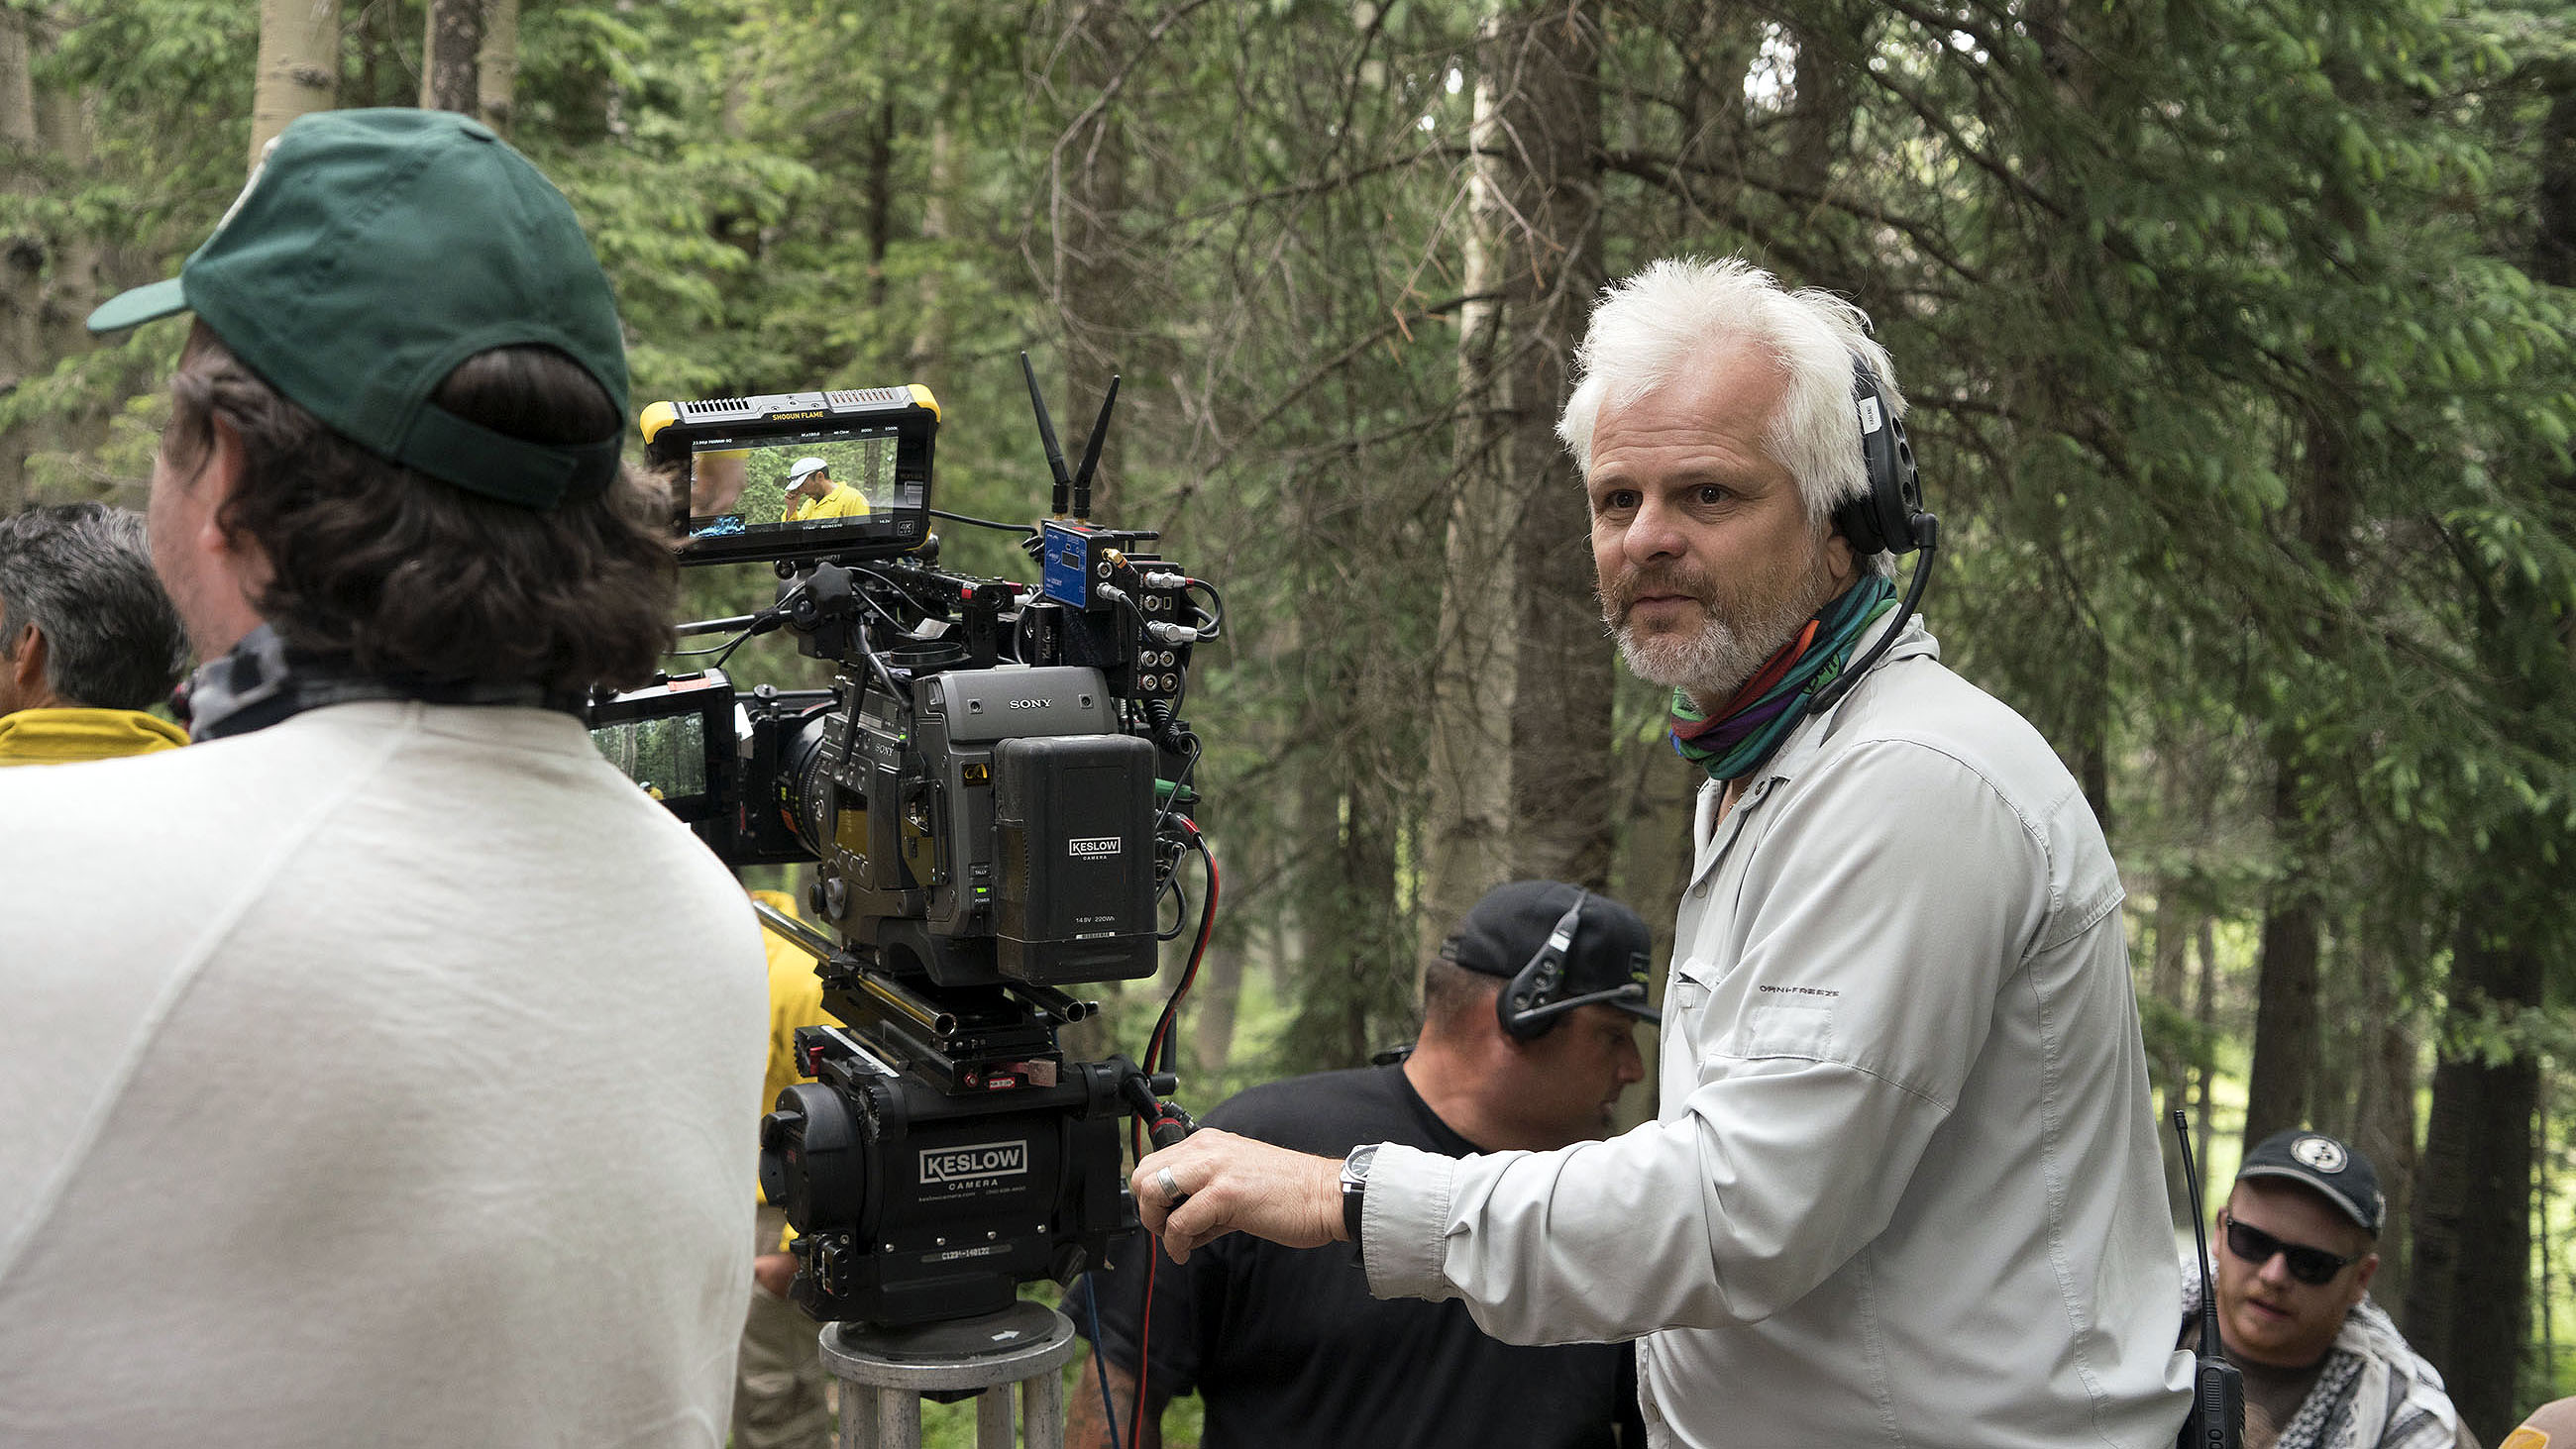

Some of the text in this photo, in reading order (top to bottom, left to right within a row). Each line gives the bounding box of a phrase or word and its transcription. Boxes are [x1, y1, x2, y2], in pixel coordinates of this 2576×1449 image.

[1009, 698, 1052, 709] SONY
[875, 742, 895, 757] SONY
[1072, 840, 1118, 855] KESLOW
[926, 1148, 1020, 1179] KESLOW
[948, 1178, 999, 1191] CAMERA
